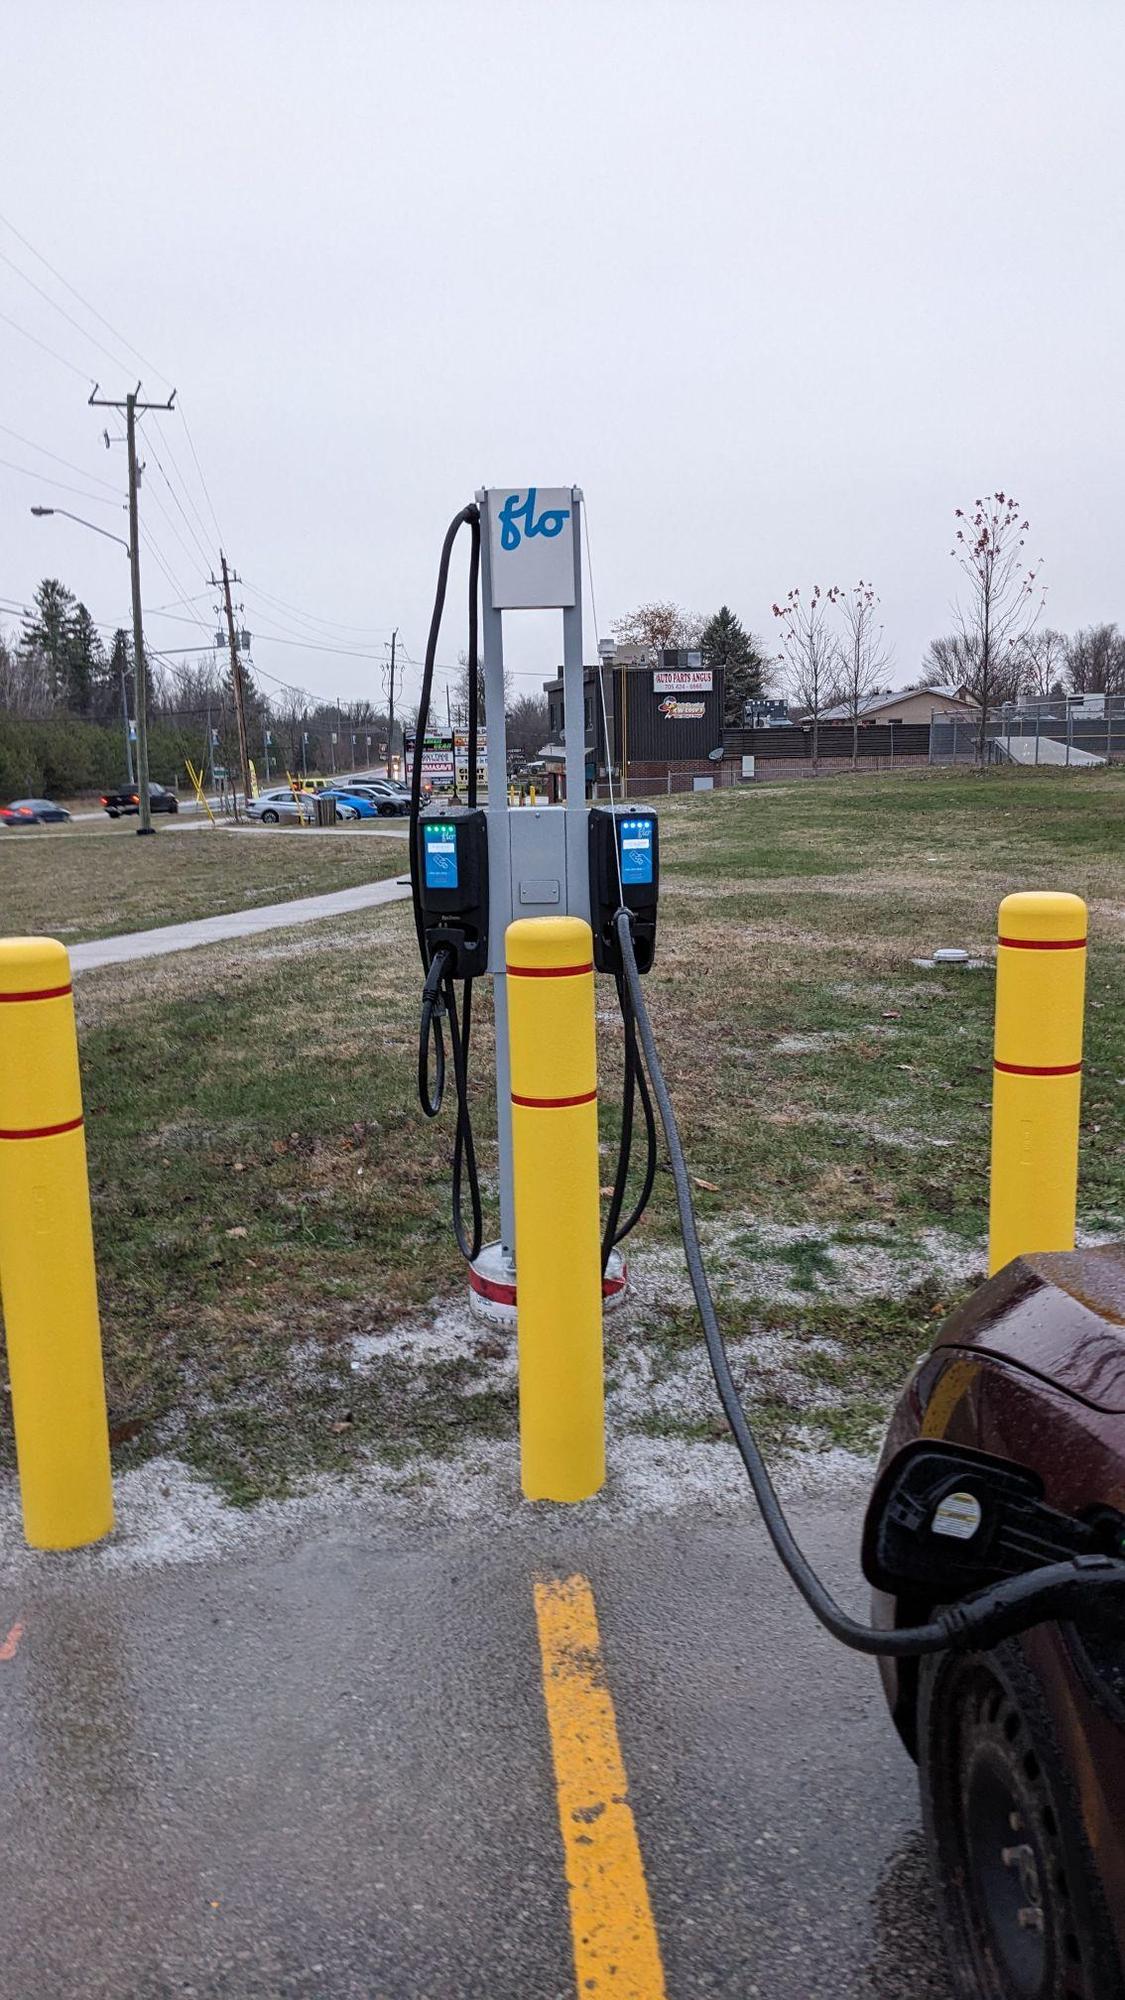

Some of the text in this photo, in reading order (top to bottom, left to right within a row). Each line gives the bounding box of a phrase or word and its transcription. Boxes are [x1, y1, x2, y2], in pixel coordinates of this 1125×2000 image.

[498, 487, 570, 551] flo
[656, 672, 711, 683] AUTO PARTS ANGUS
